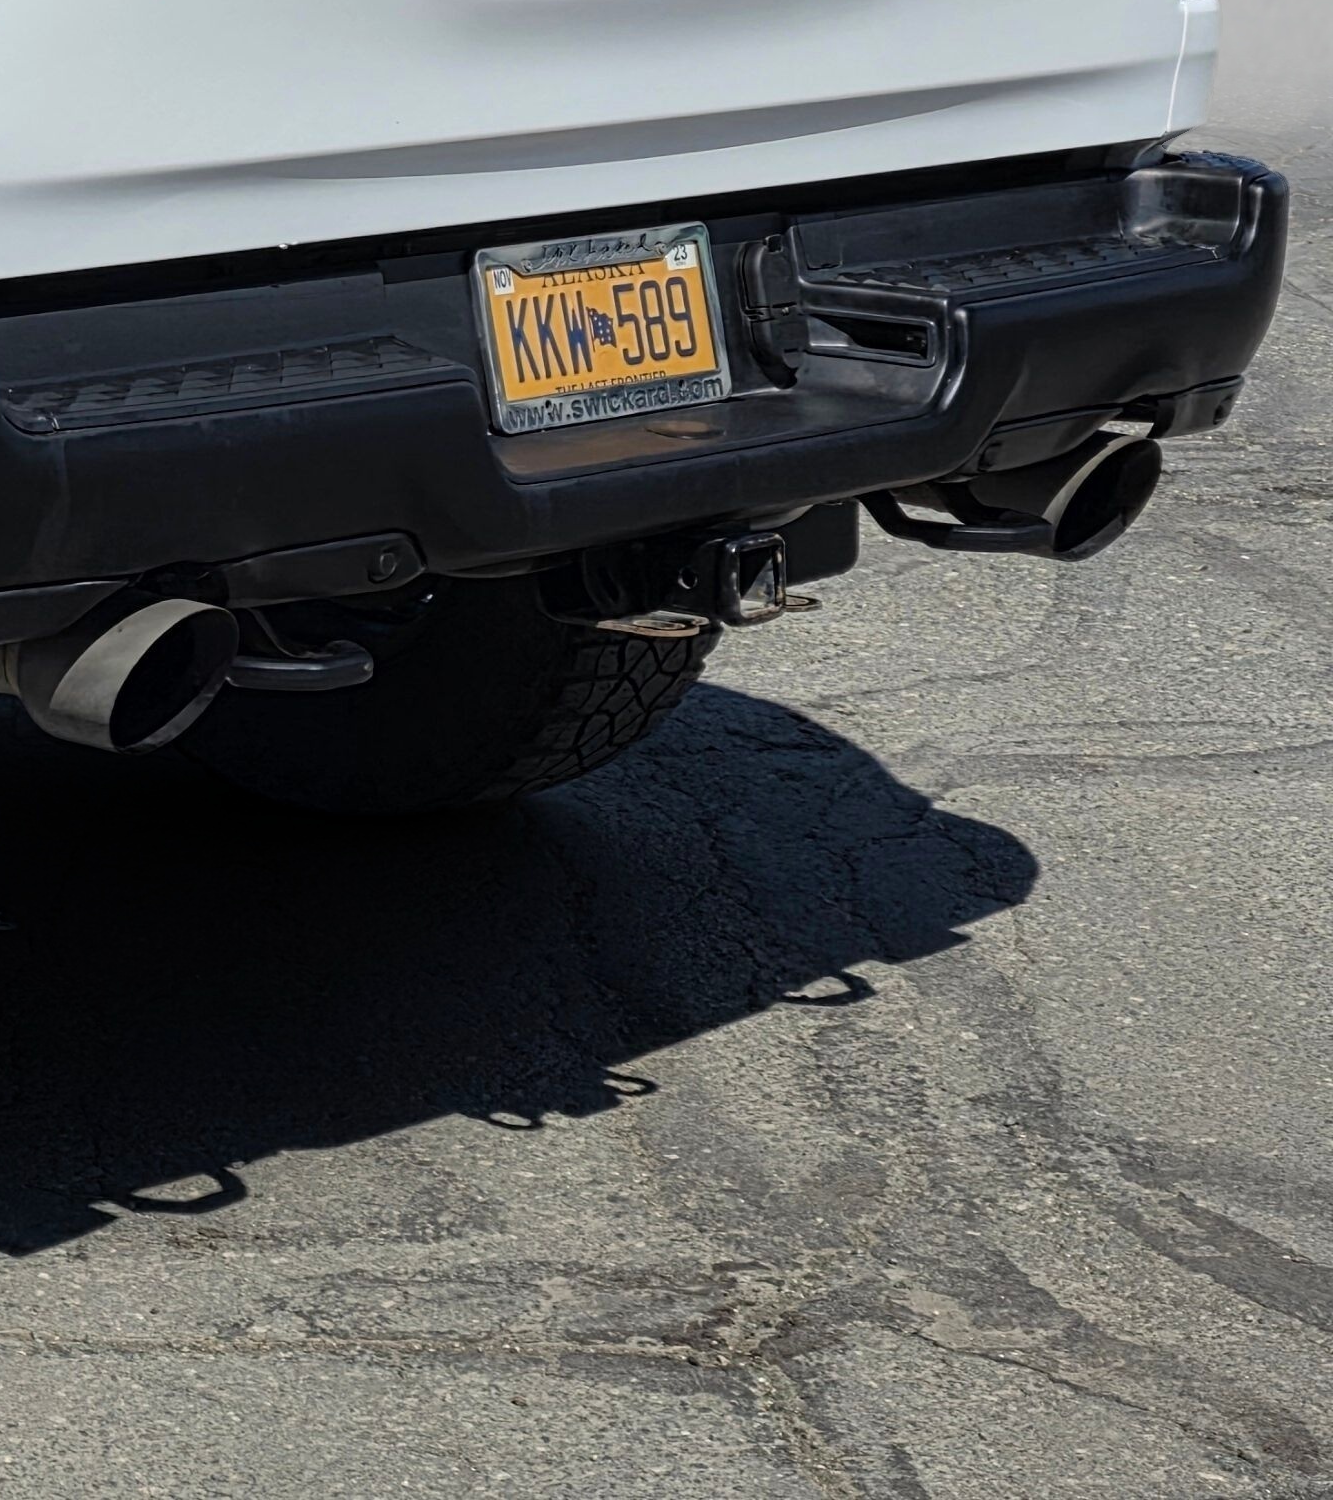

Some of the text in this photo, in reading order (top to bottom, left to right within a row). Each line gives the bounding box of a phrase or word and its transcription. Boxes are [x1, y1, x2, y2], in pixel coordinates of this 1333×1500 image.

[673, 244, 688, 262] 23
[493, 268, 513, 290] NOV
[541, 262, 646, 288] ALASKA
[506, 276, 698, 383] KKW 589
[508, 377, 724, 429] www.swickard.com
